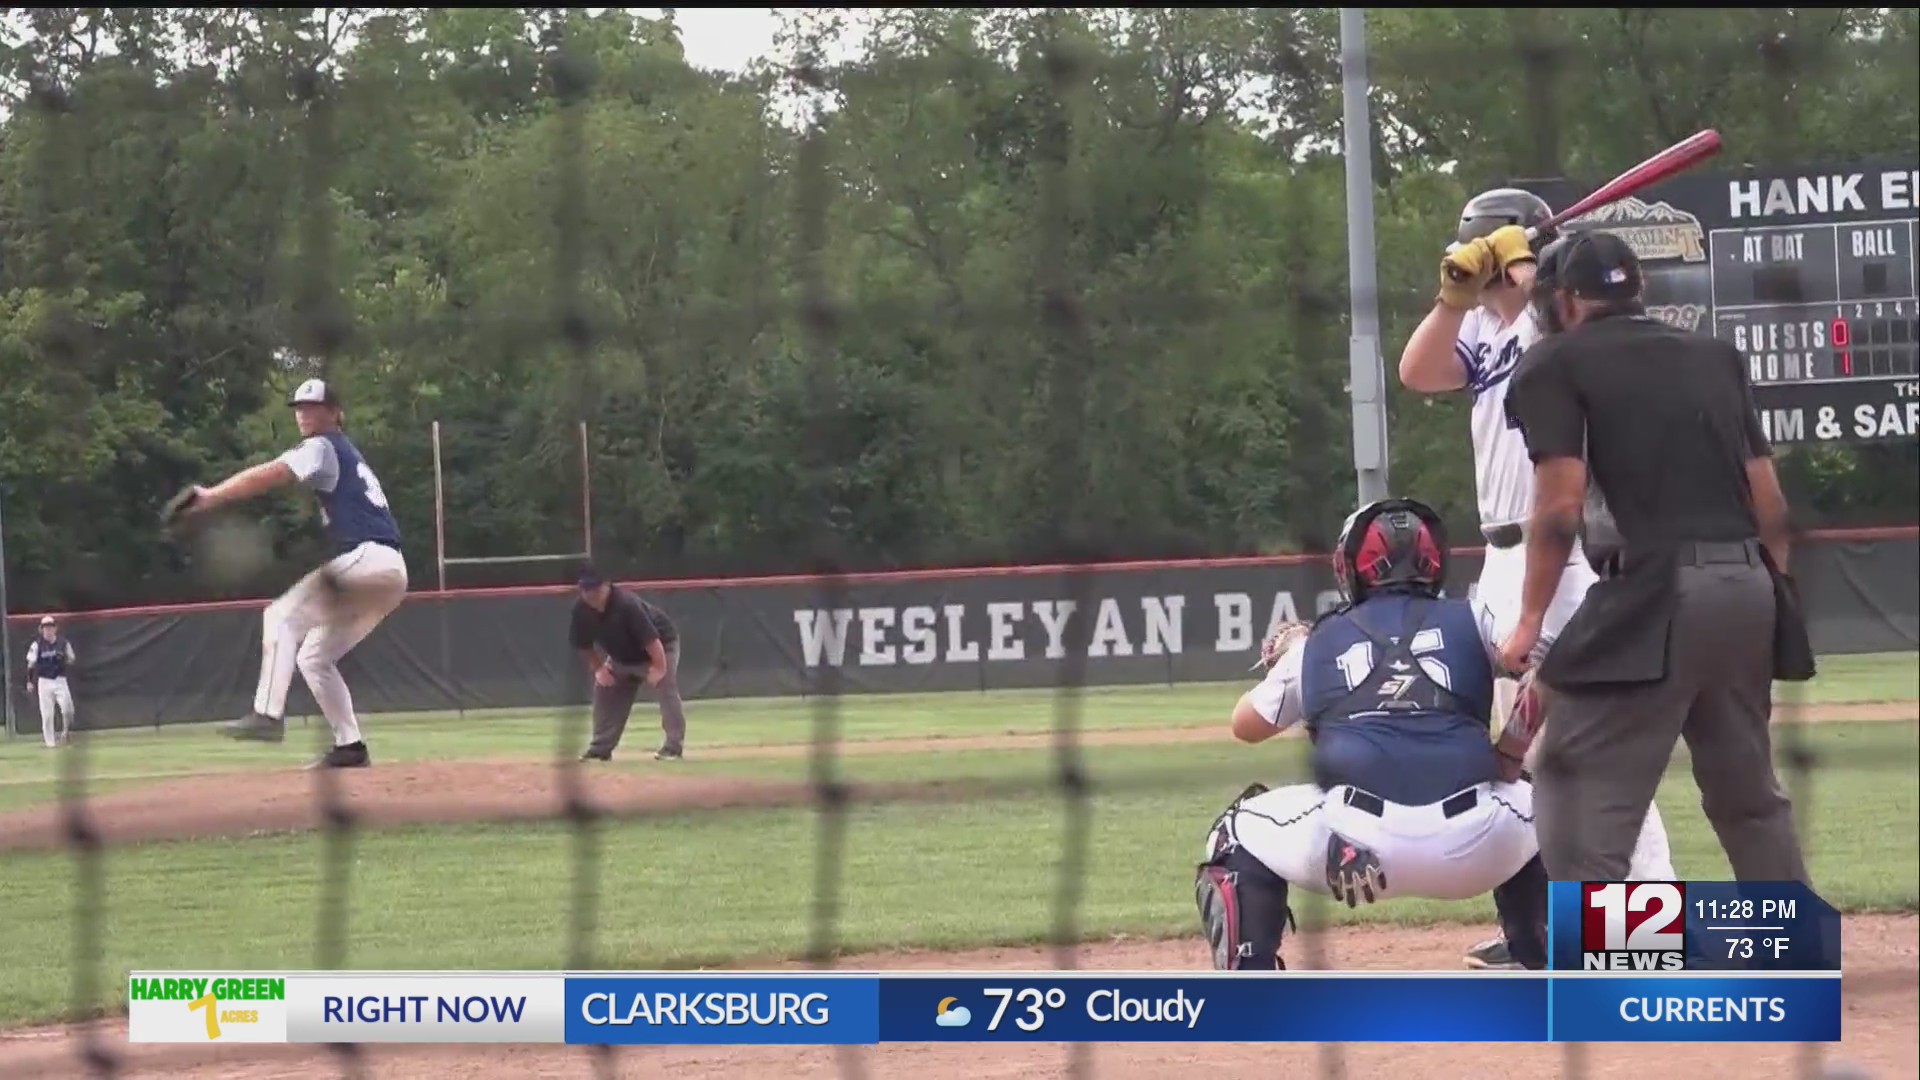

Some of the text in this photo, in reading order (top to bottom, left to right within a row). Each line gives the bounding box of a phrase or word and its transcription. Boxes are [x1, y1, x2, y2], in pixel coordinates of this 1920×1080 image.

[1729, 174, 1866, 218] HANK
[1743, 233, 1804, 263] AT BAT
[1852, 228, 1896, 258] BALL
[1856, 304, 1863, 318] 2
[1875, 303, 1883, 317] 3
[1895, 303, 1902, 316] 4
[1734, 321, 1825, 352] GUESTS
[1750, 352, 1815, 381] HOME
[1815, 406, 1843, 440] &
[794, 595, 1185, 667] WESLEYAN
